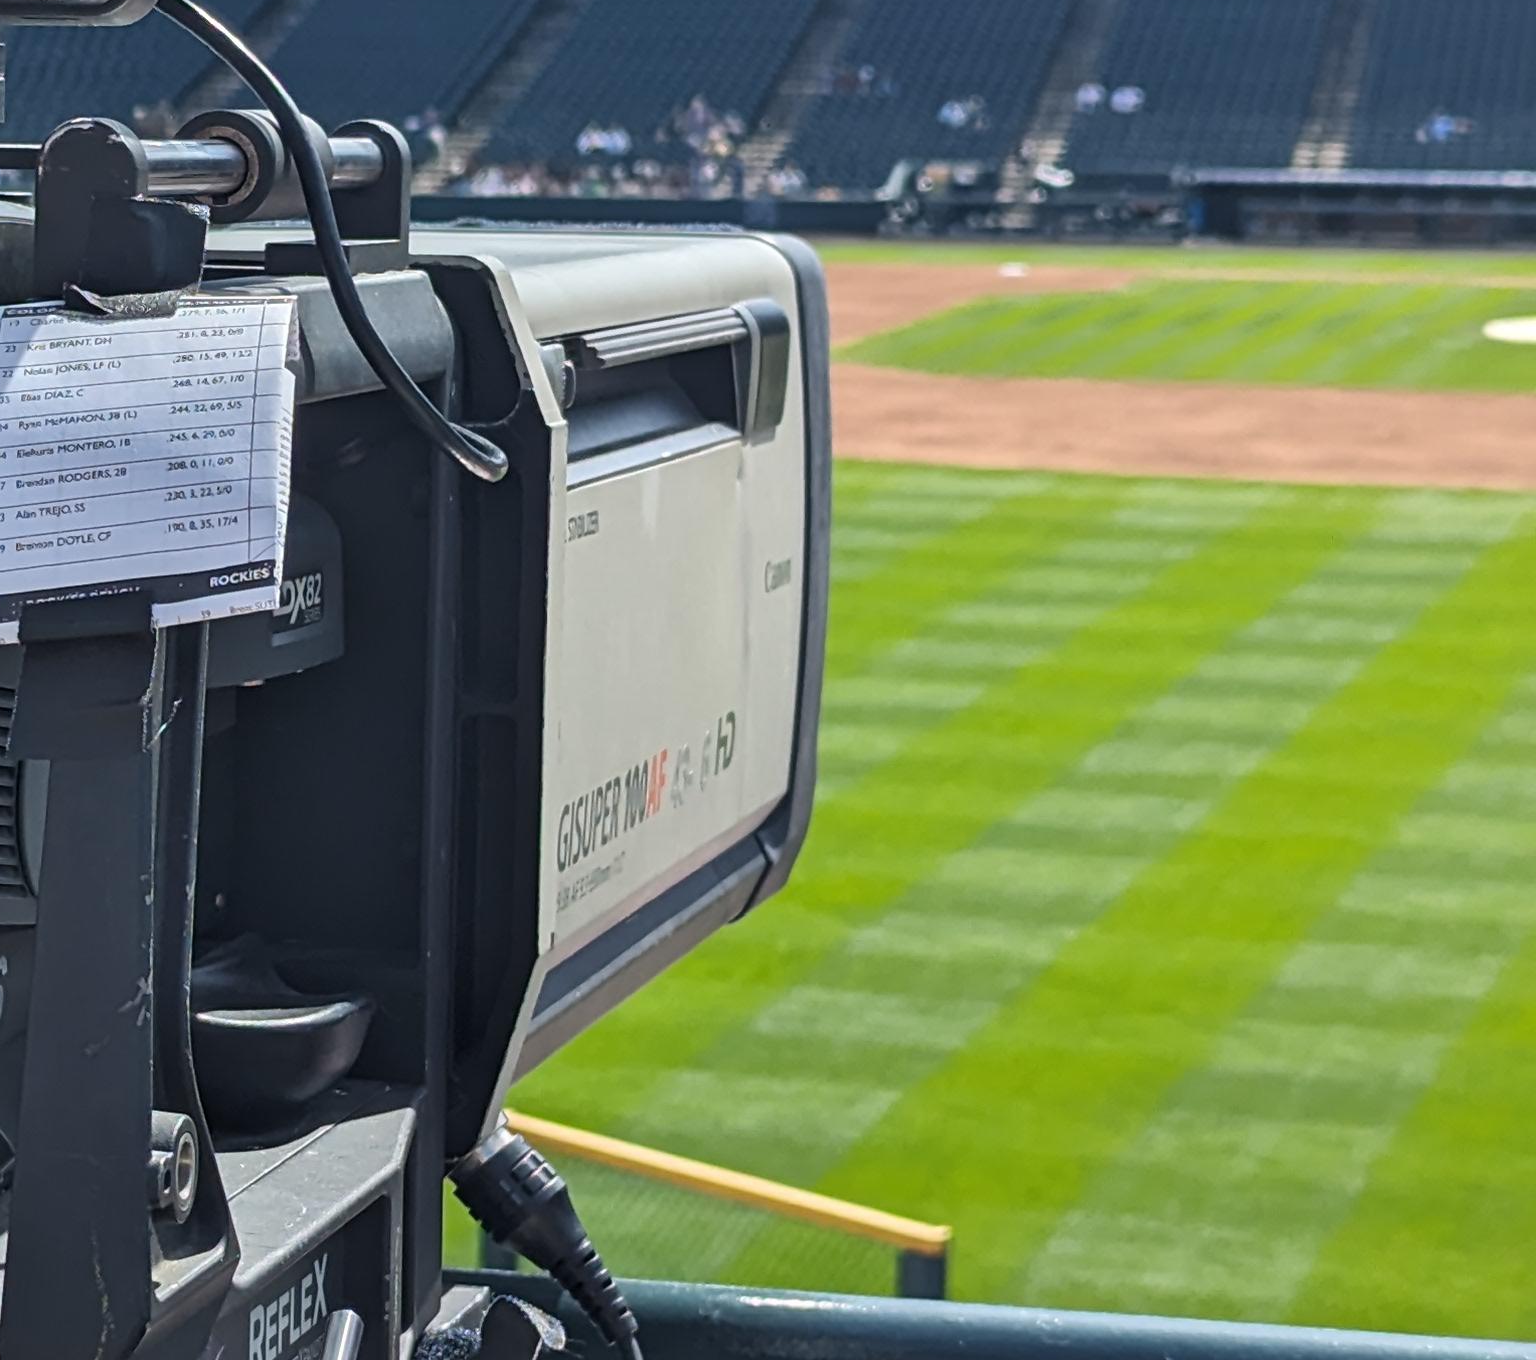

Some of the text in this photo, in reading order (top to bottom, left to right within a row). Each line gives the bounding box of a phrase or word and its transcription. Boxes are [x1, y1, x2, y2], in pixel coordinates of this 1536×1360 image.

[57, 439, 116, 453] MONTERO,
[57, 467, 127, 484] RODGERS, 2B
[38, 503, 72, 517] TREJO,
[74, 503, 86, 513] SS
[0, 530, 112, 554] 9 DOYLE, CF
[209, 566, 270, 588] ROCKIES
